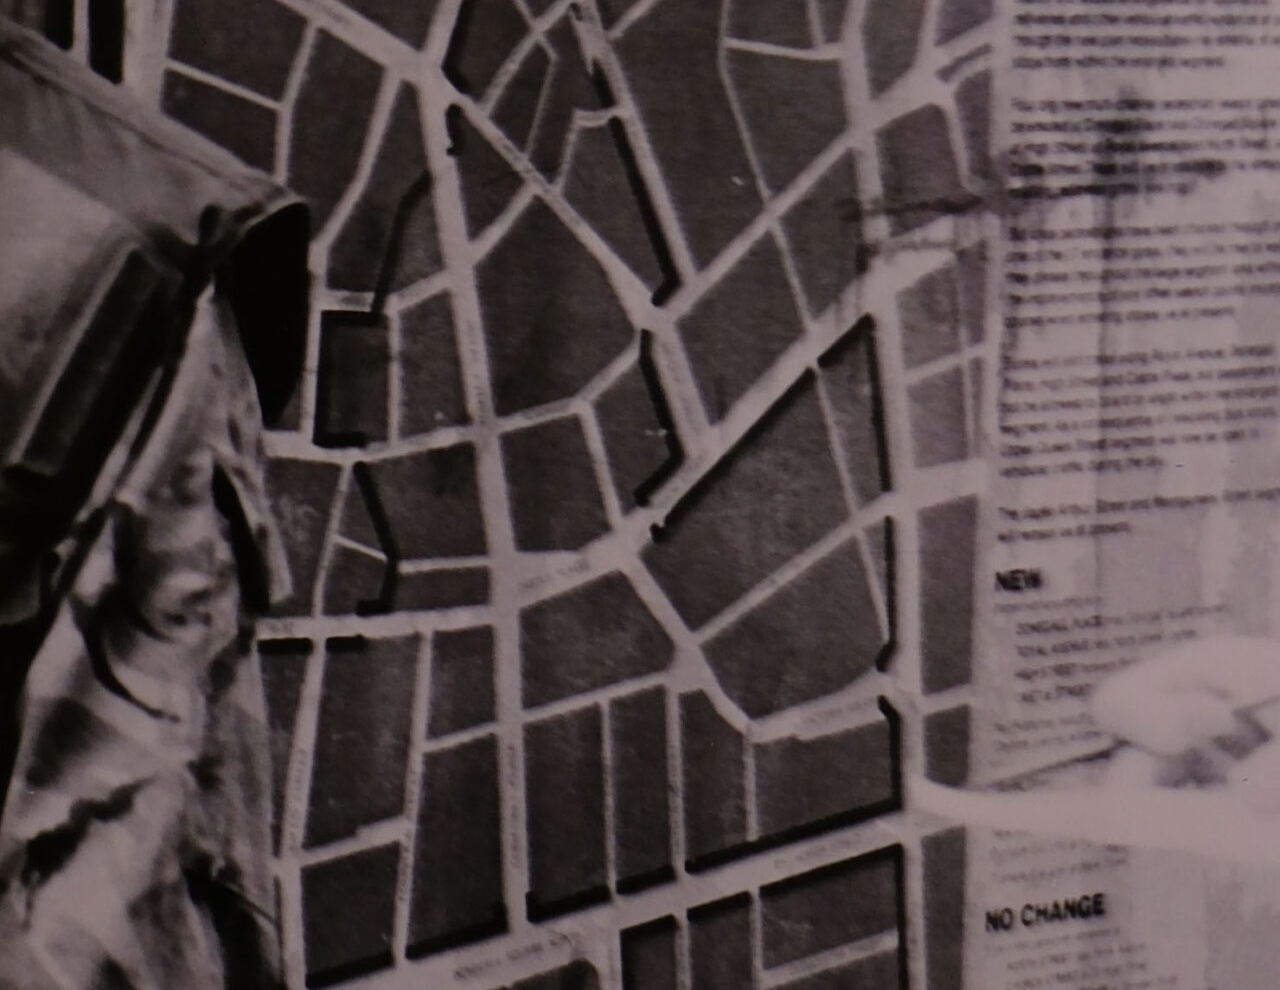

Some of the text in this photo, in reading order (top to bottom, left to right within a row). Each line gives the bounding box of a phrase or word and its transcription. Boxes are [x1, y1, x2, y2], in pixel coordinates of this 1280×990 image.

[995, 568, 1042, 592] NEW
[985, 893, 1106, 932] NO CHANGE
